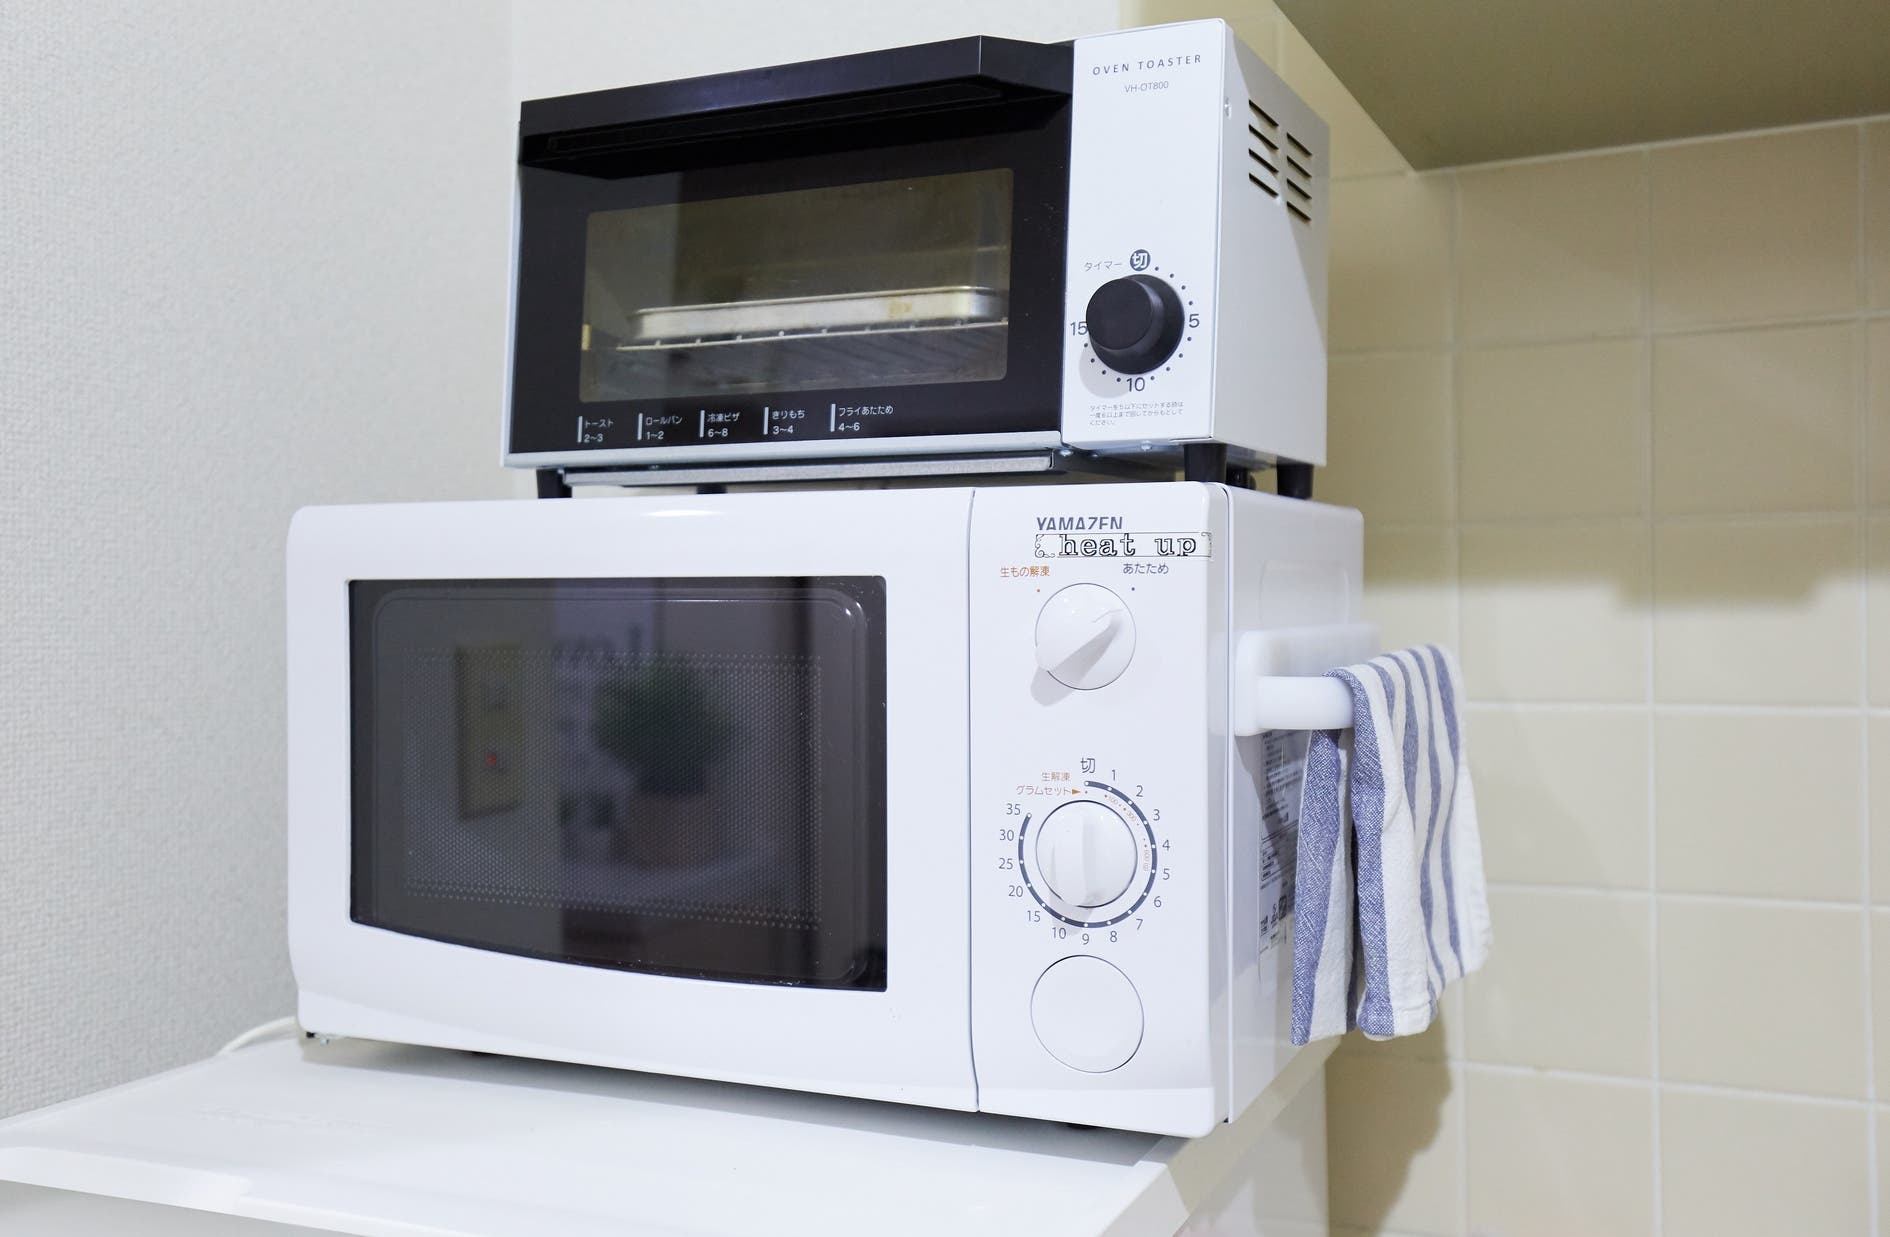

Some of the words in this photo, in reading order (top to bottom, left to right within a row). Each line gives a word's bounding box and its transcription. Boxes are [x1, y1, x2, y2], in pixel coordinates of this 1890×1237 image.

[1092, 63, 1130, 76] OVEN
[1138, 54, 1202, 71] TOASTER
[1125, 80, 1169, 93] VH-OT800
[1084, 261, 1122, 271] タイマー
[1131, 250, 1149, 270] 切
[1189, 314, 1200, 328] 5
[1070, 321, 1088, 336] 15
[1126, 377, 1145, 392] 10
[707, 412, 740, 422] 冷凍ピザ
[772, 410, 805, 420] きりもち
[839, 405, 894, 417] フライあたため
[584, 418, 614, 428] トースト
[646, 416, 683, 425] ロールパン
[1059, 533, 1136, 557] heat
[1154, 537, 1197, 557] up
[1000, 566, 1050, 577] 生もの解凍
[1123, 563, 1169, 574] あたため
[1080, 757, 1095, 774] 切
[1041, 772, 1071, 782] 生解凍
[1111, 769, 1116, 781] 1
[1016, 786, 1071, 796] グラムセット
[1136, 785, 1143, 797] 2
[1006, 803, 1021, 815] 35
[1153, 809, 1160, 821] 3
[999, 829, 1014, 841] 30
[1162, 840, 1171, 851] 4
[998, 858, 1013, 870] 25
[1163, 868, 1170, 880] 5
[1008, 885, 1023, 897] 20
[1154, 896, 1162, 907] 6
[1027, 910, 1040, 923] 15
[1136, 919, 1143, 930] 7
[1052, 927, 1066, 939] 10
[1110, 931, 1117, 942] 8
[1082, 934, 1089, 945] 9
